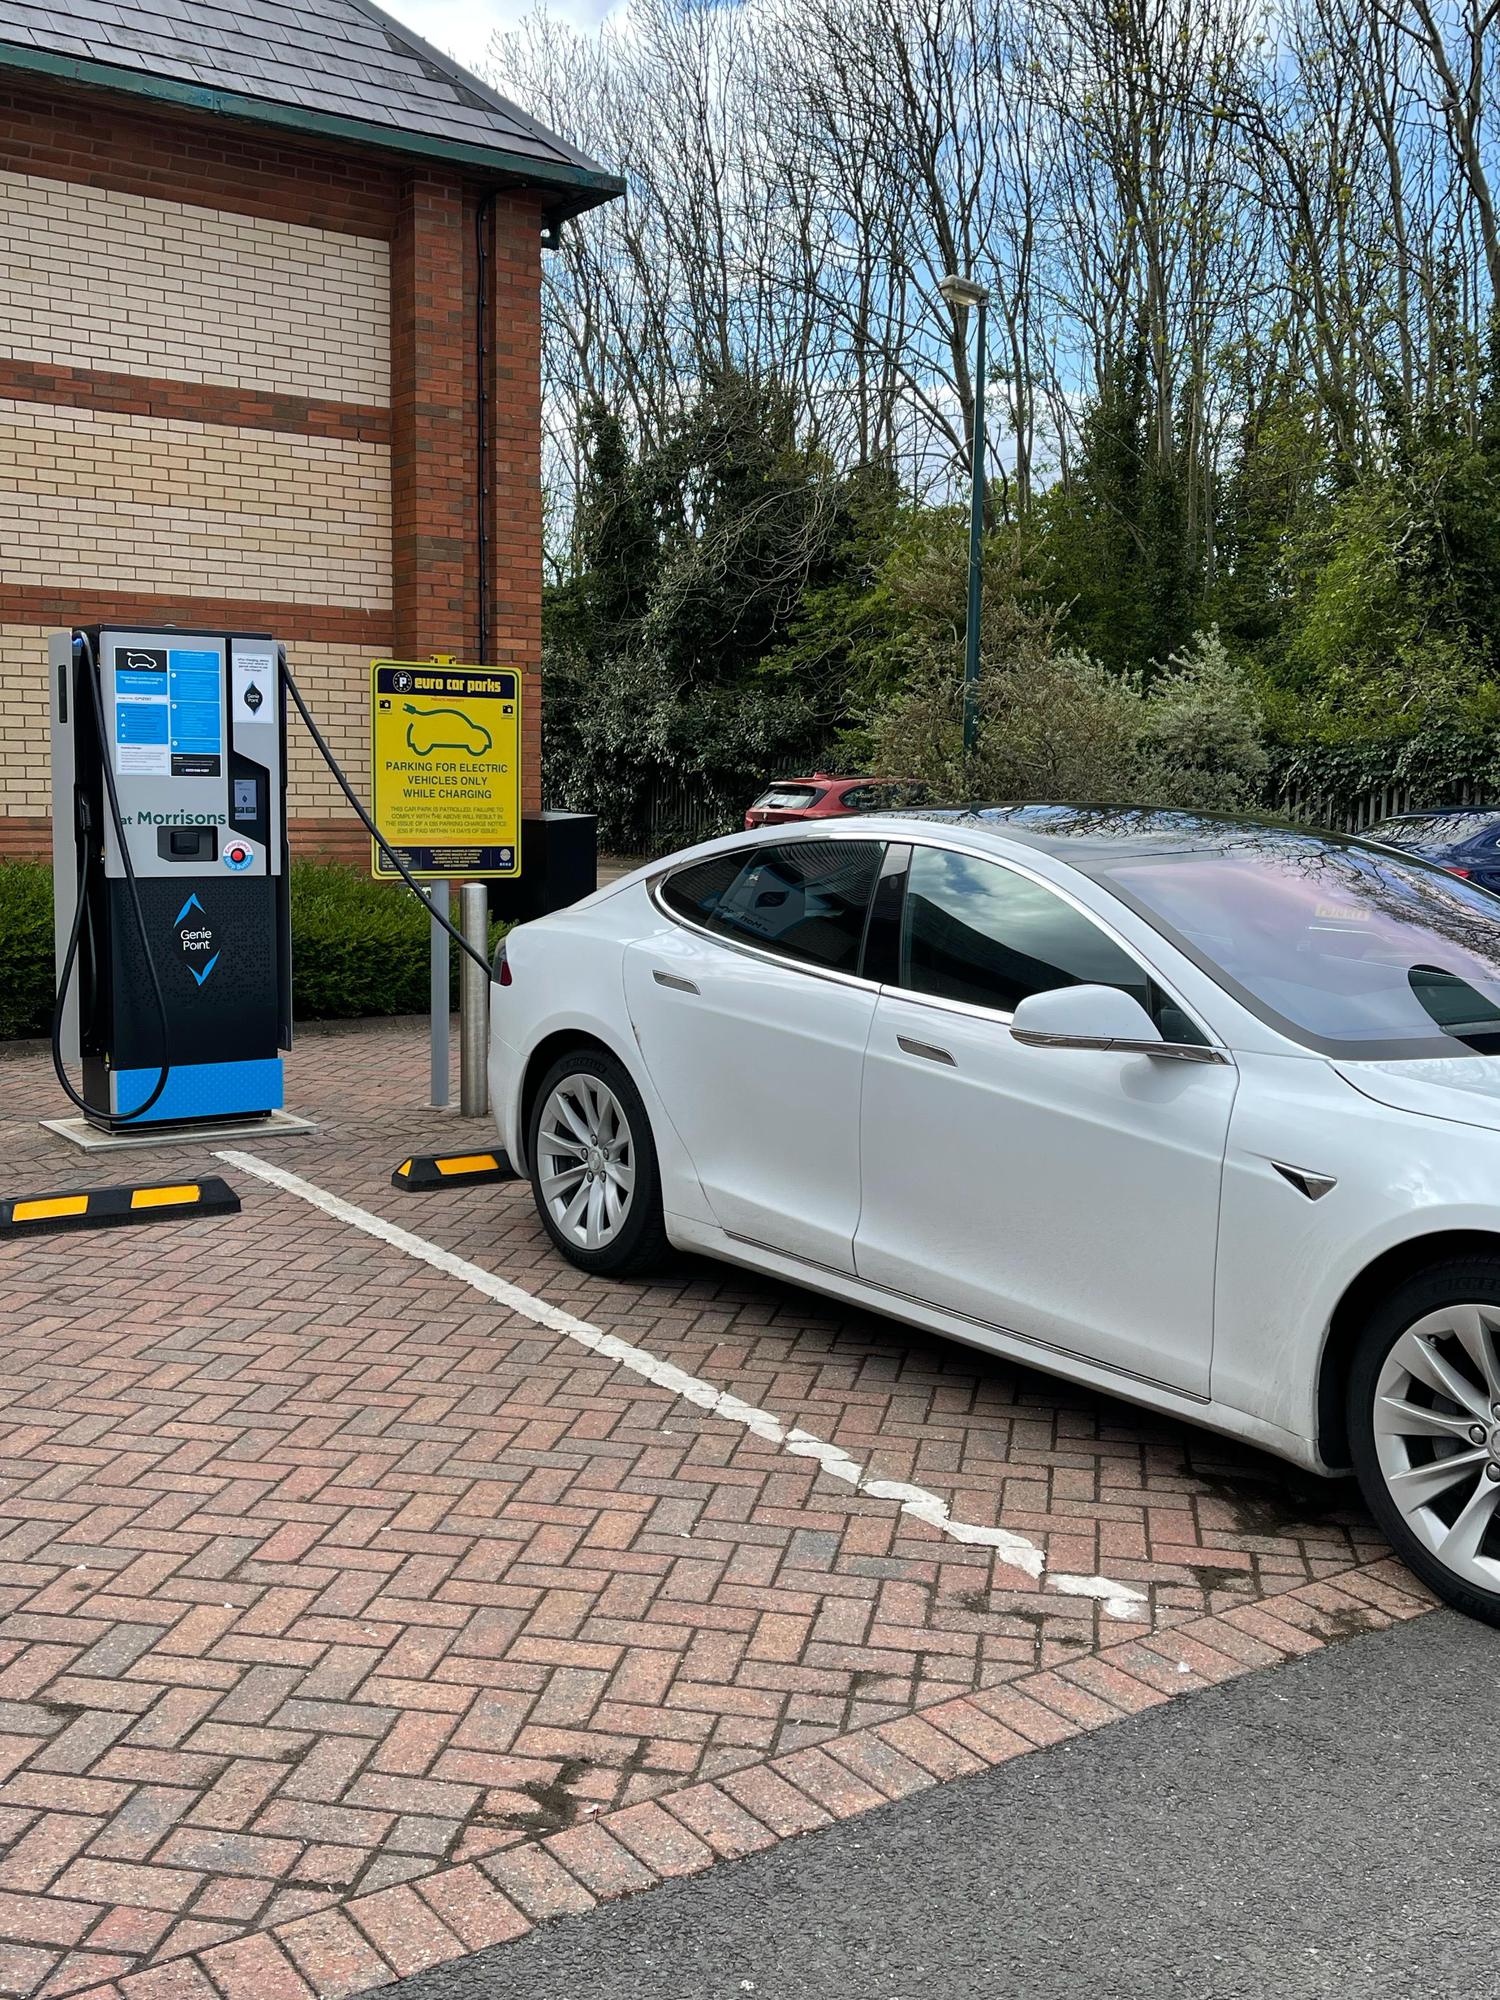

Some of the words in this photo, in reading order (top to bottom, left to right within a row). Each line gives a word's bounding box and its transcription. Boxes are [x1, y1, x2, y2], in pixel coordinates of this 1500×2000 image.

[414, 677, 444, 690] euro
[446, 679, 464, 691] car
[467, 678, 501, 693] parks
[386, 761, 432, 772] PARKING
[436, 763, 456, 772] FOR
[459, 764, 508, 773] ELECTRIC
[408, 775, 458, 785] VEHICLES
[461, 776, 488, 786] ONLY
[403, 788, 436, 798] WHILE
[438, 789, 492, 799] CHARGING
[120, 816, 133, 825] at
[137, 808, 226, 825] Morrisons
[180, 927, 212, 940] Genie
[183, 940, 210, 951] Point
